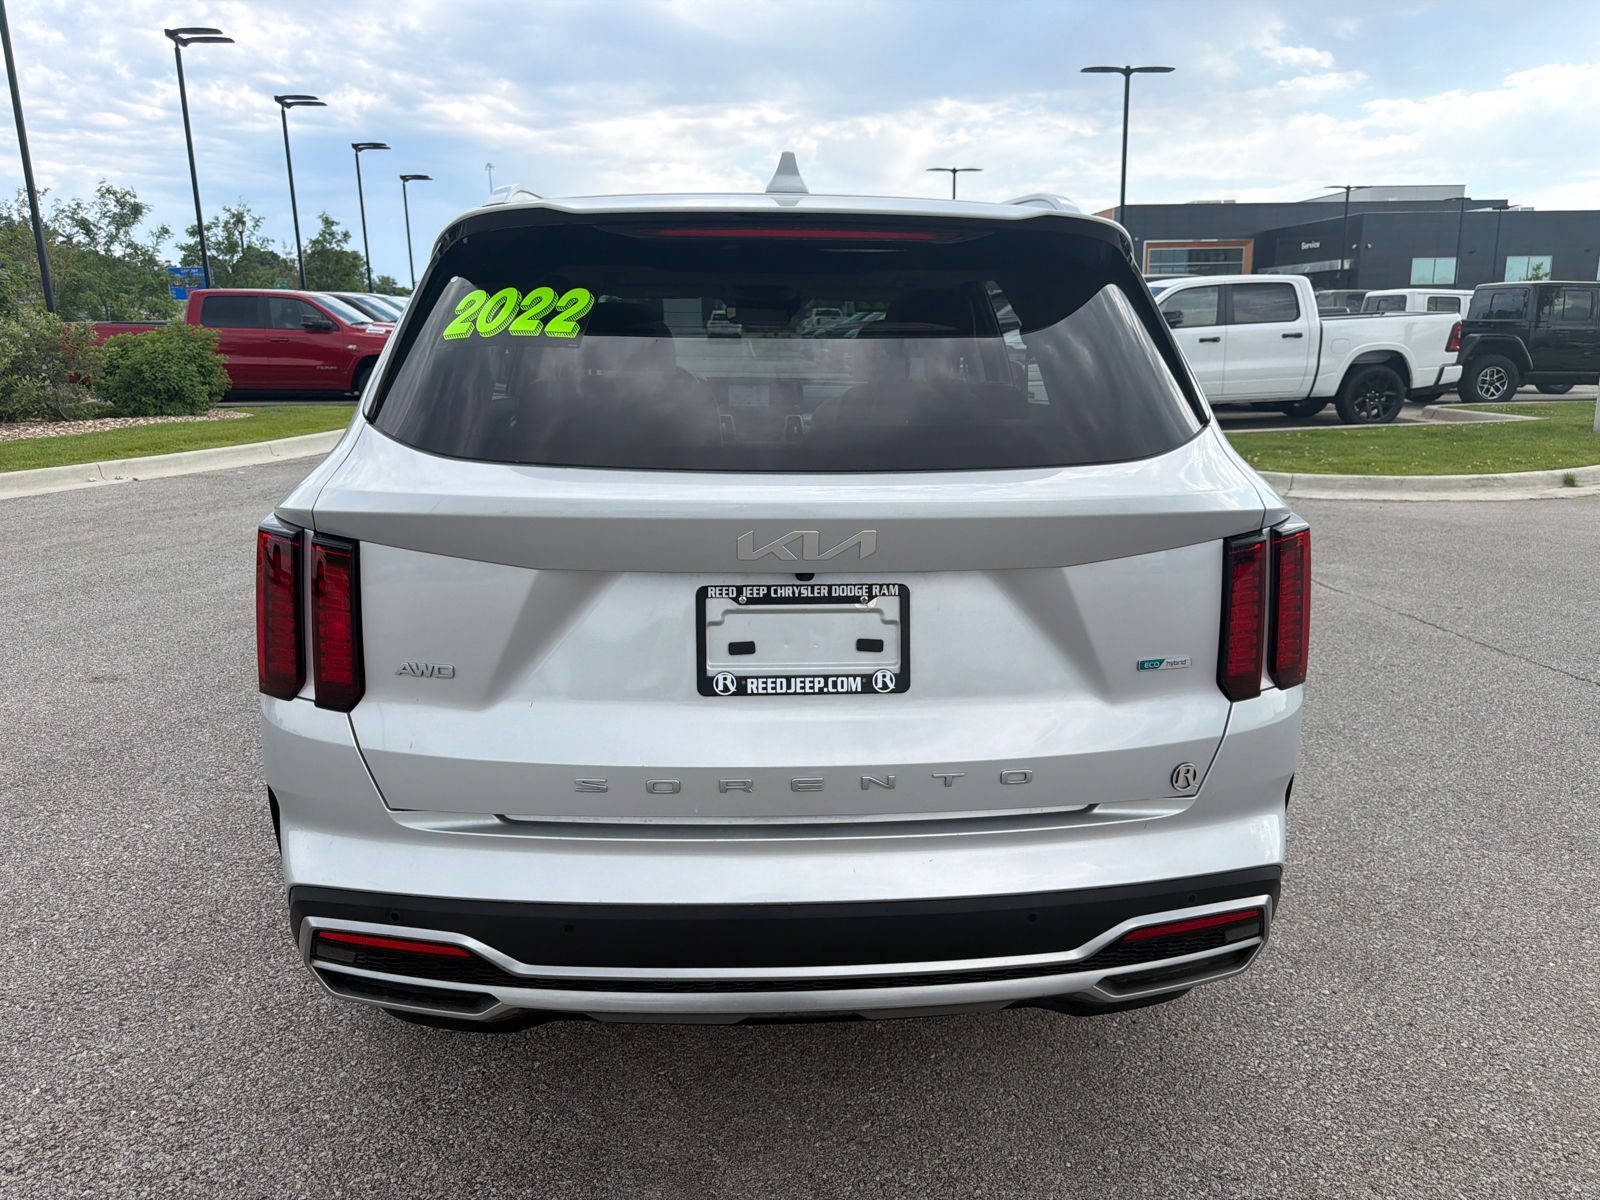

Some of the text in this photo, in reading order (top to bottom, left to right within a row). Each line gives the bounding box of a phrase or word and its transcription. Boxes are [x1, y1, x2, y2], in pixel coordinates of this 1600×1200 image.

[1301, 241, 1320, 250] Service
[443, 287, 595, 340] 2022
[736, 530, 877, 561] KIA
[708, 584, 899, 598] REED JEEP CHRYSLER DODGE RAM
[395, 662, 455, 679] AWD
[1166, 658, 1186, 668] hybrid
[747, 677, 862, 693] REEDJEEP.COM
[574, 769, 1033, 794] SORENTO
